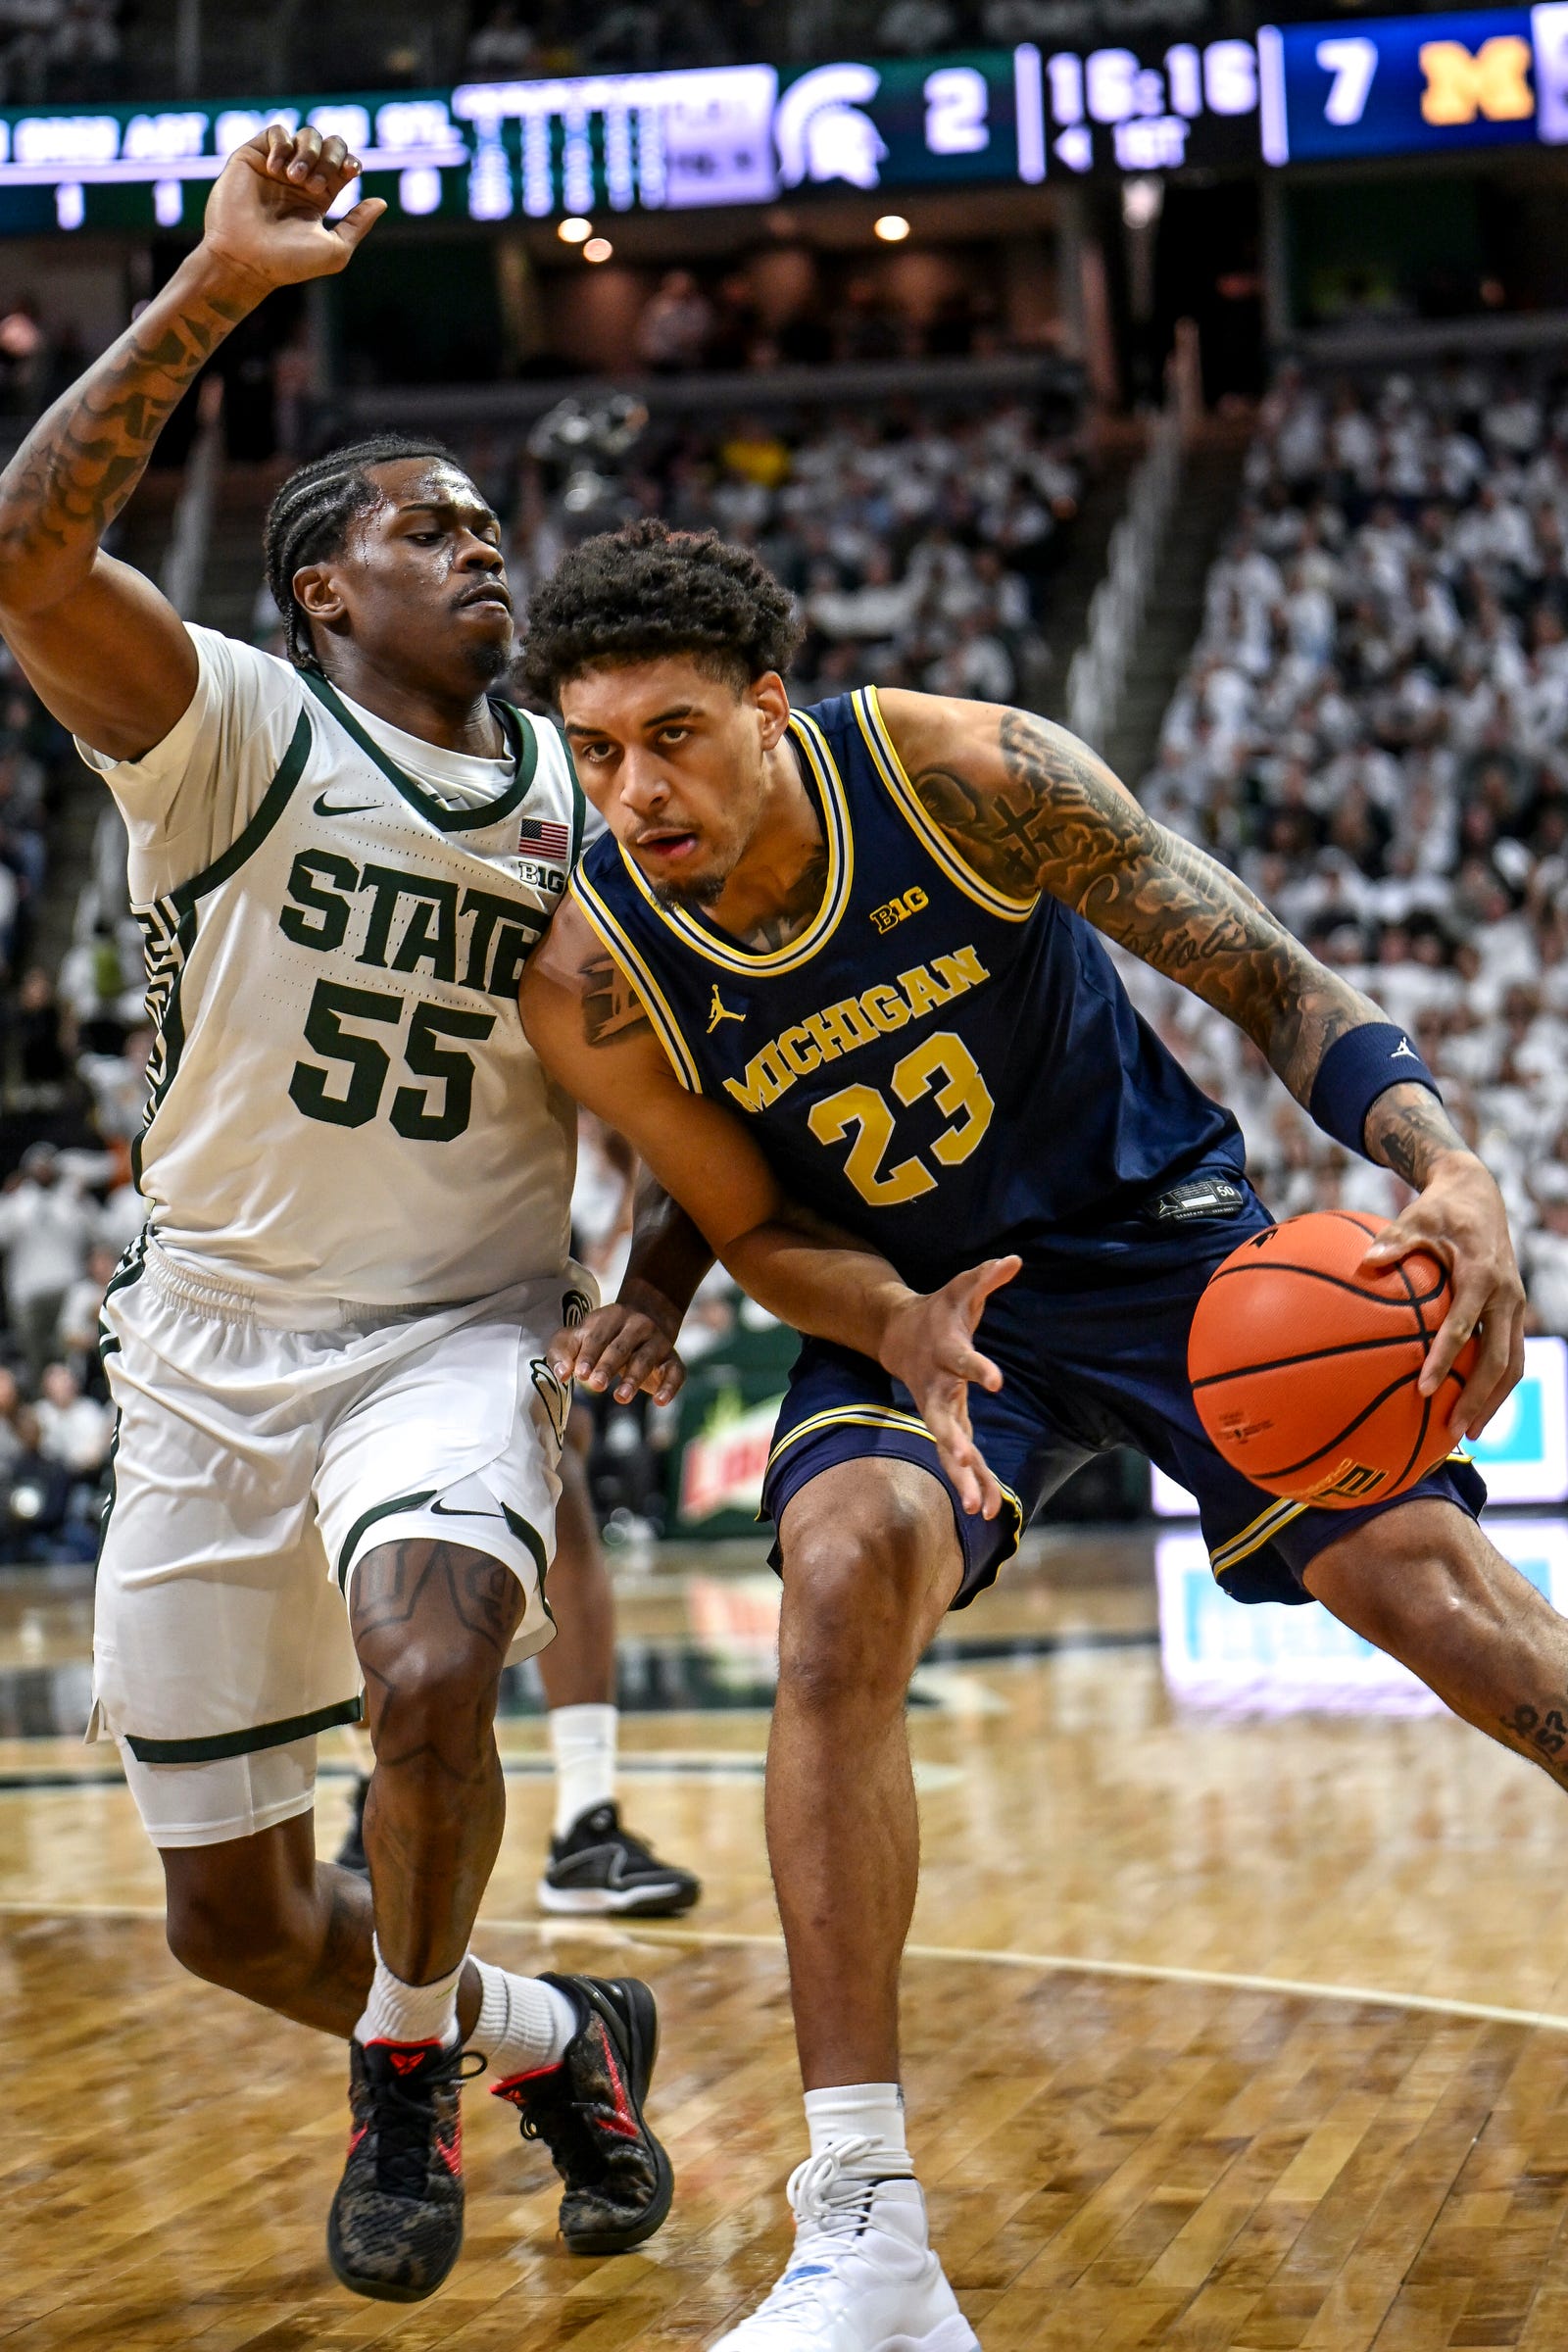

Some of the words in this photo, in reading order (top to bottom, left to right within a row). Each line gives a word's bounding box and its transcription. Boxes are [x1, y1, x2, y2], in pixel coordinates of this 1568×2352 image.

[923, 66, 990, 155] 2
[1316, 36, 1379, 125] 7
[1418, 35, 1535, 126] M
[288, 978, 497, 1142] 55
[722, 945, 991, 1113] MICHIGAN
[808, 1031, 995, 1206] 23
[1216, 1186, 1235, 1197] 50
